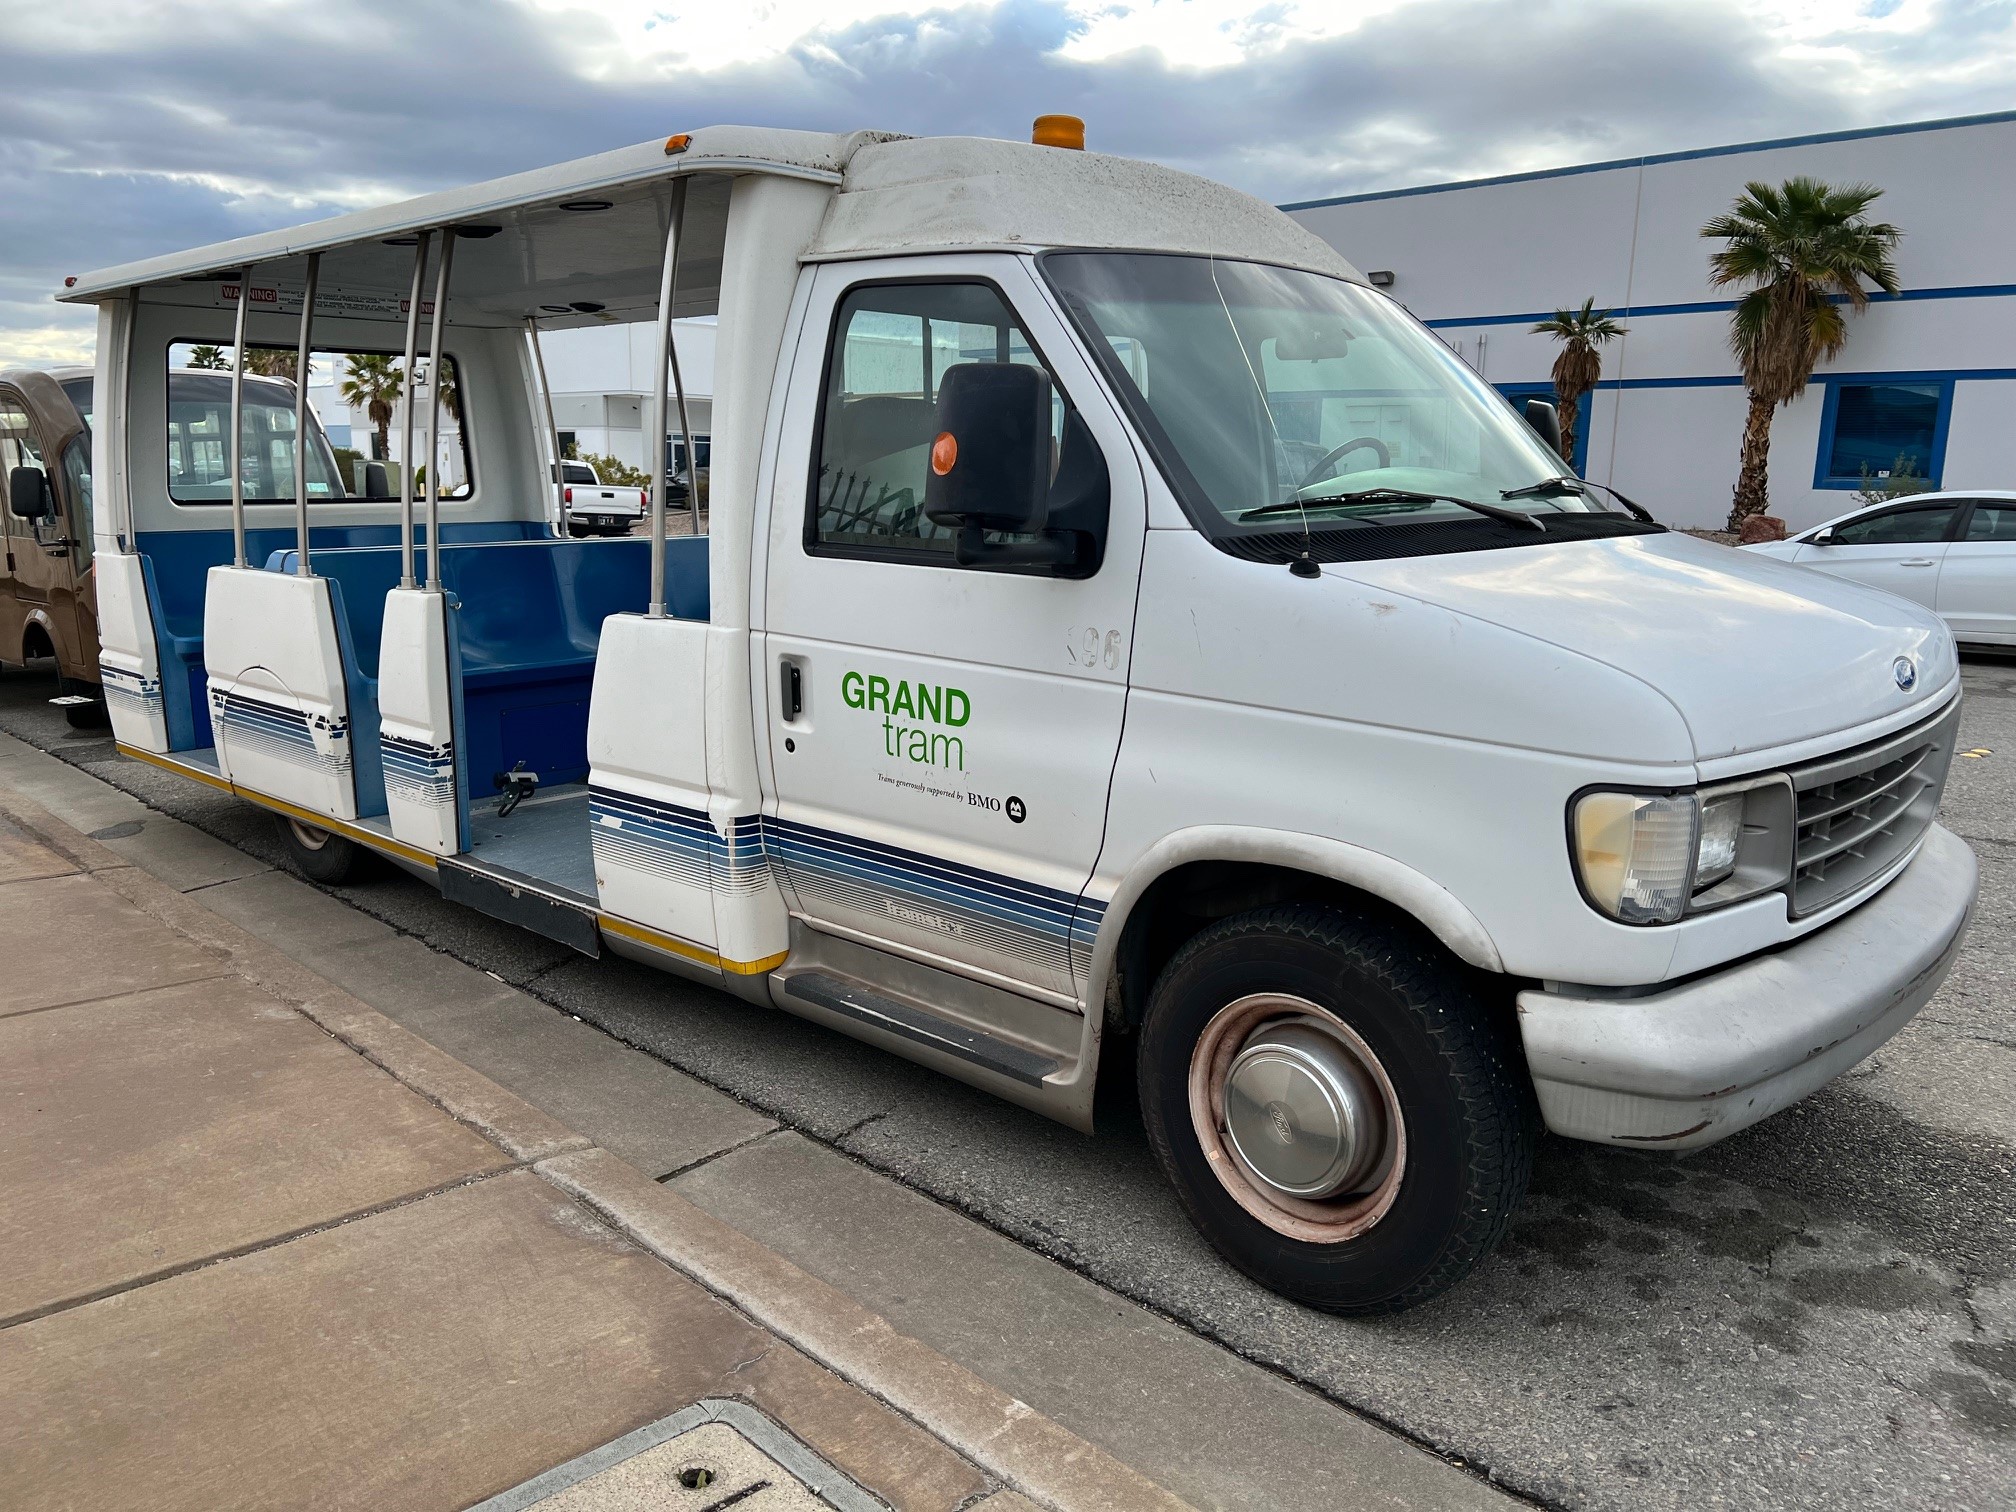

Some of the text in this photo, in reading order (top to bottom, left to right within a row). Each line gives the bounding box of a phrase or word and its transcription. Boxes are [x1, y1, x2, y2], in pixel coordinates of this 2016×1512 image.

[222, 286, 276, 301] WANING!
[841, 671, 971, 727] GRAND
[881, 715, 963, 771] tram
[877, 773, 1001, 812] Trams generously supported by BMO
